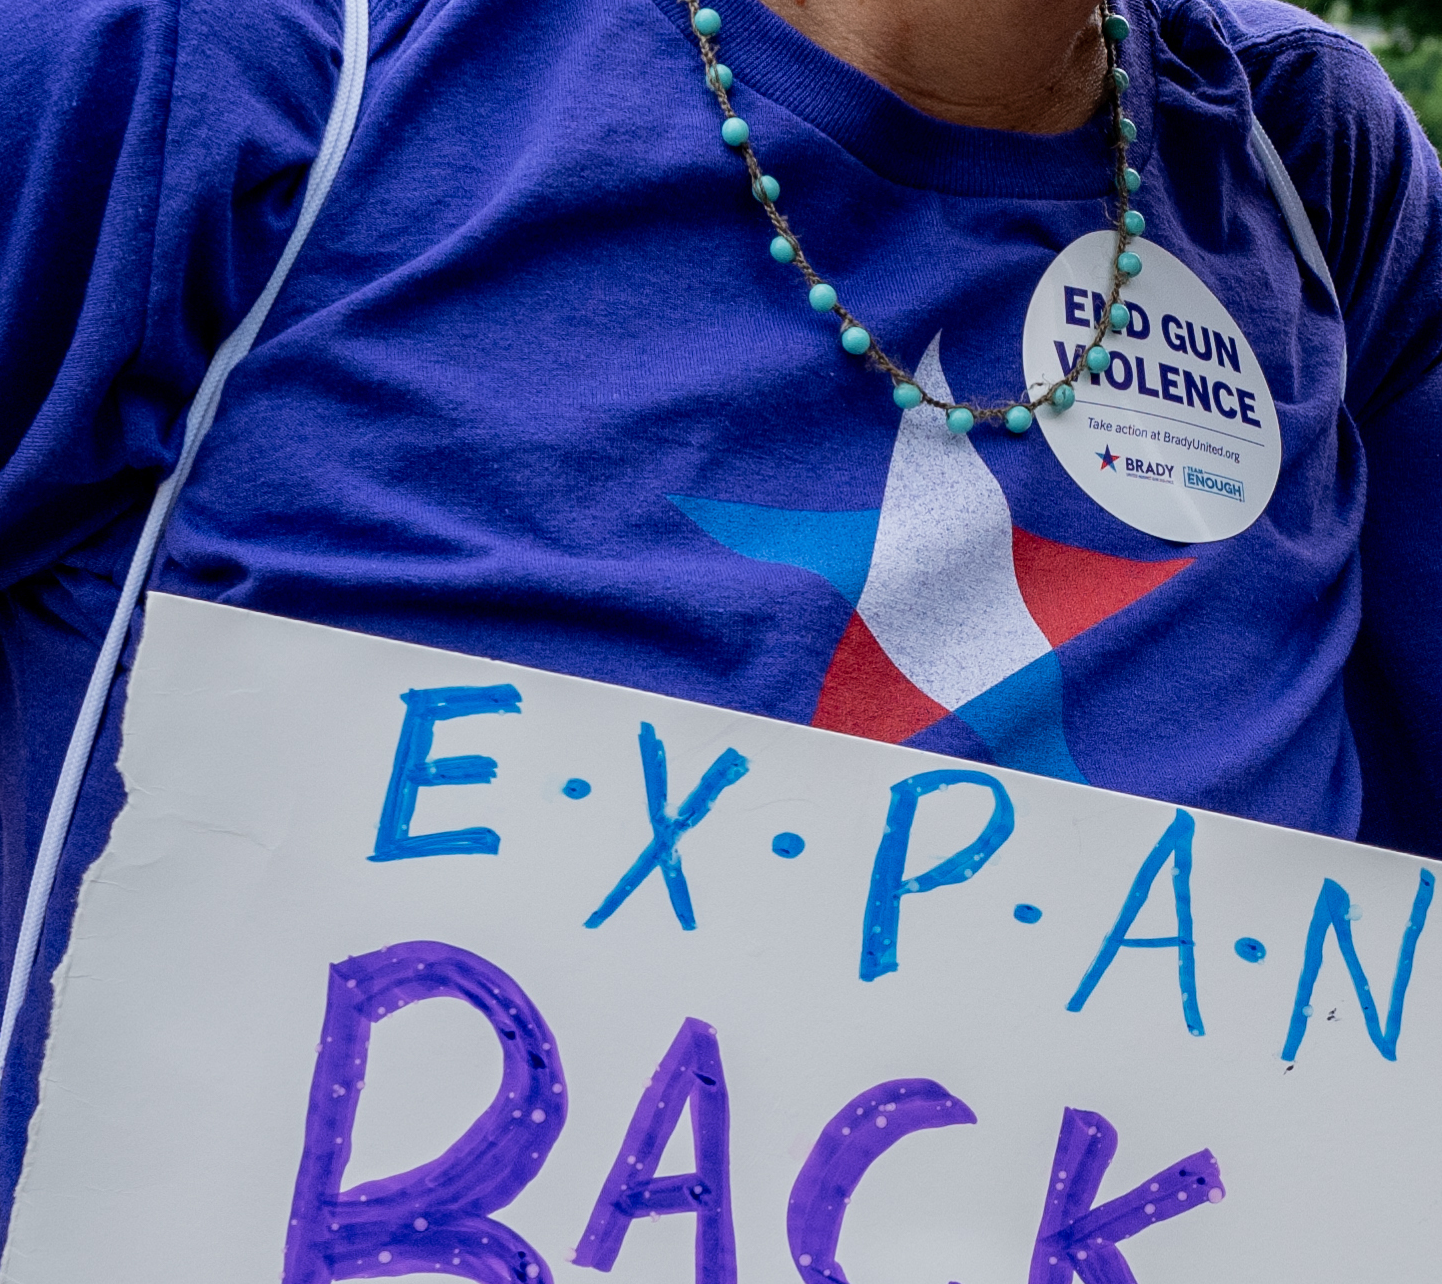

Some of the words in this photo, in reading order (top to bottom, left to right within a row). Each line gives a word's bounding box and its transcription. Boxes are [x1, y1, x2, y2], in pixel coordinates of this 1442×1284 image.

[1161, 313, 1241, 374] GUN
[1087, 417, 1113, 433] Take
[1115, 424, 1148, 438] action
[1150, 430, 1161, 441] at
[1163, 431, 1241, 464] BradyUnited.org
[1125, 457, 1175, 479] BRADY
[1187, 472, 1242, 497] ENOUGH
